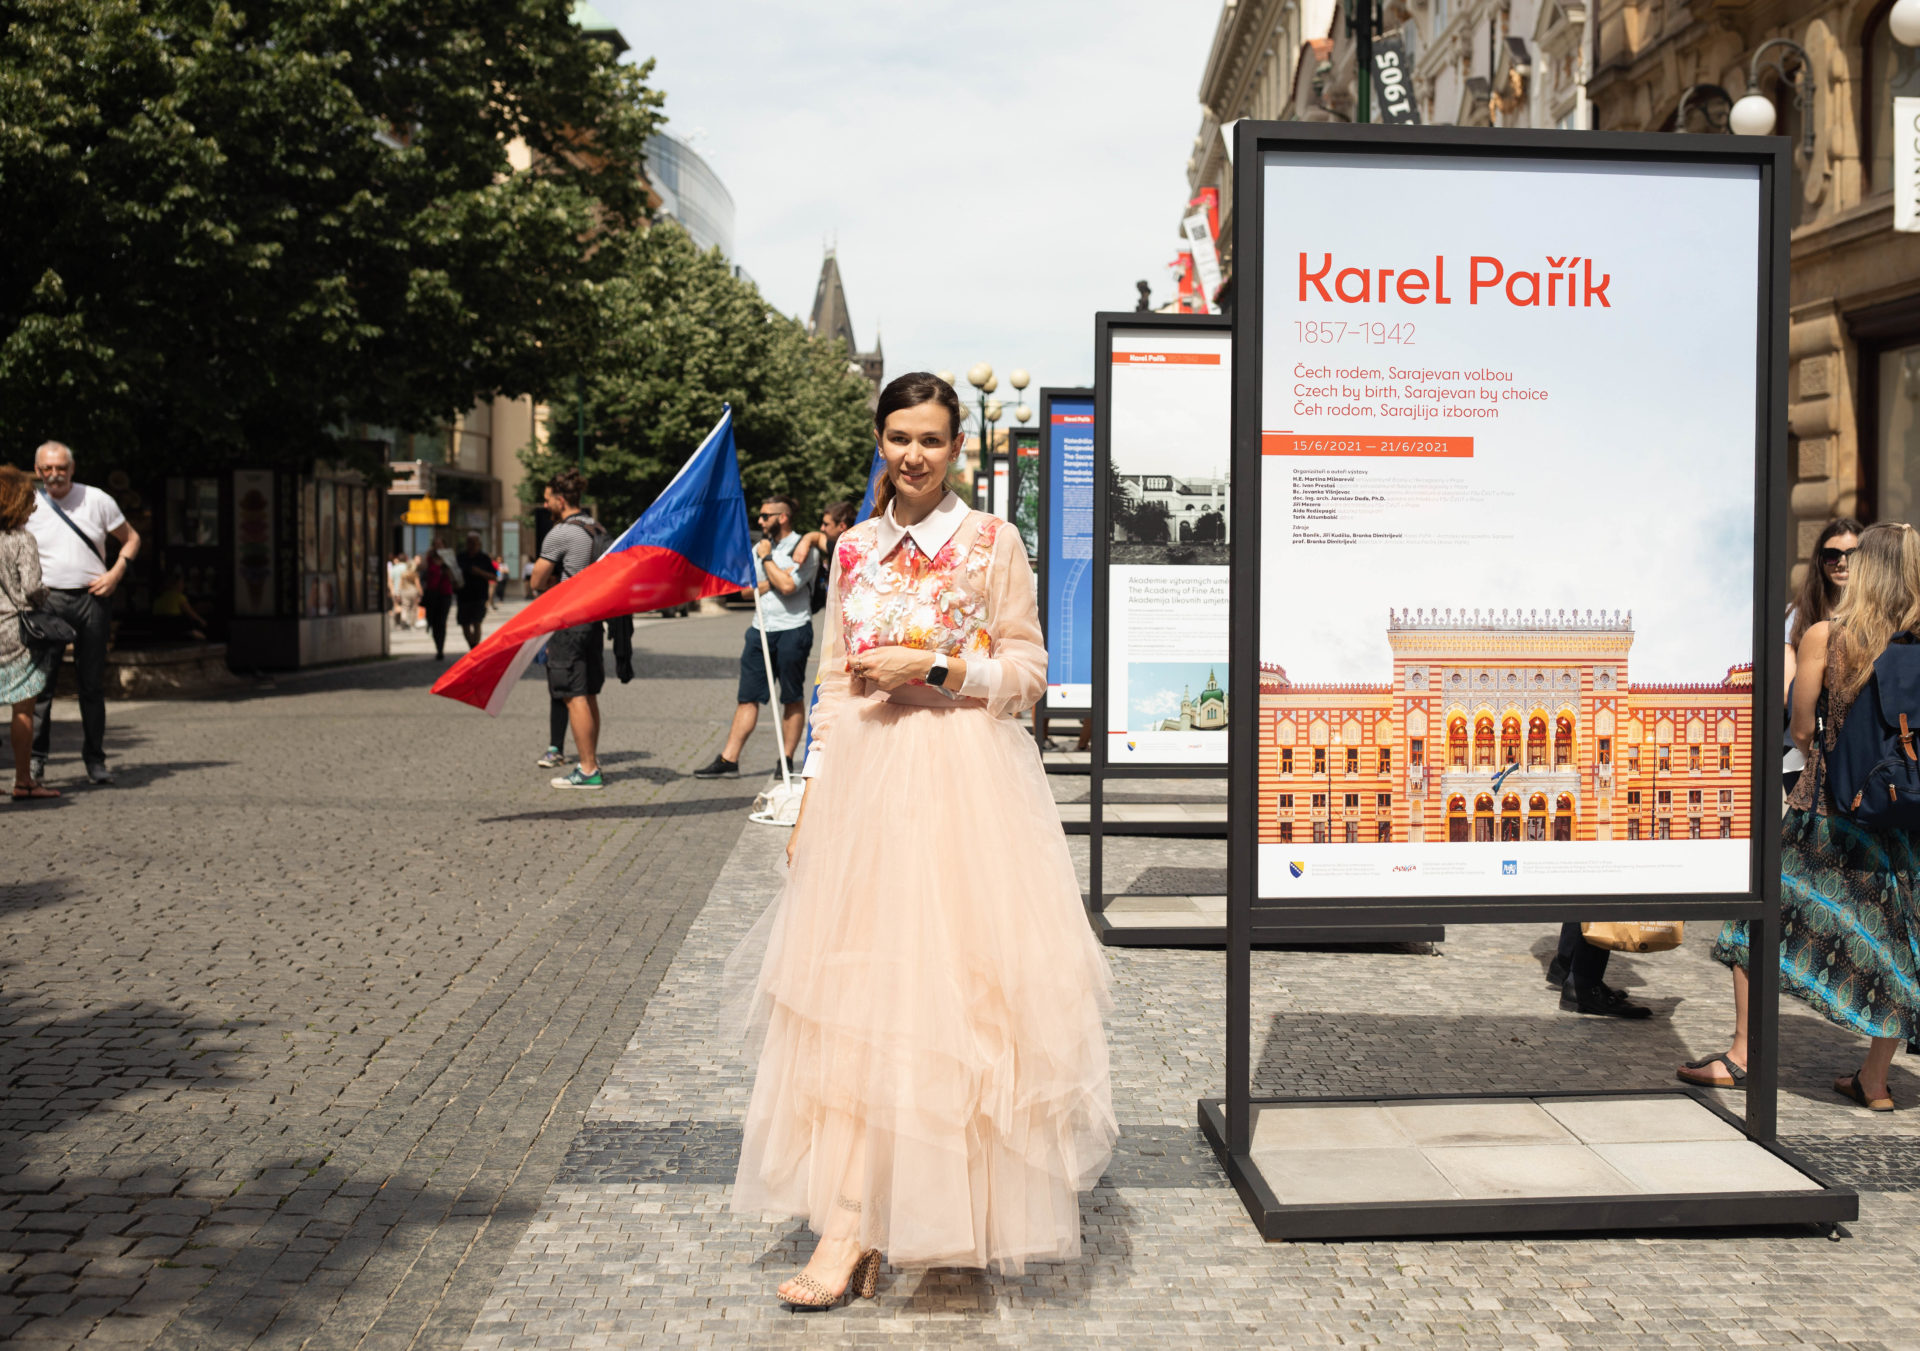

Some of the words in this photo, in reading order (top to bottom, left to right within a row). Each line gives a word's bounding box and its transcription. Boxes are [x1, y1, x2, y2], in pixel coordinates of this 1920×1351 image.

[1375, 50, 1411, 117] 1905
[1298, 251, 1452, 305] Karel
[1469, 255, 1612, 308] Pařík
[1293, 362, 1332, 379] Čech
[1335, 365, 1385, 381] rodem,
[1388, 366, 1460, 384] Sarajevan
[1463, 367, 1513, 382] volbou
[1293, 383, 1338, 399] Czech
[1342, 384, 1361, 402] by
[1364, 384, 1401, 401] birth,
[1404, 385, 1476, 403] Sarajevan
[1479, 386, 1498, 404] by
[1501, 386, 1549, 401] choice
[1293, 400, 1323, 416] Čeh
[1327, 402, 1377, 418] rodom,
[1380, 403, 1439, 421] Sarajlija
[1442, 404, 1499, 419] izborom
[1293, 440, 1361, 452] 15/6/2021
[1380, 441, 1448, 453] 21/6/2021
[1128, 586, 1143, 594] The
[1143, 586, 1181, 596] Academy
[1182, 586, 1190, 594] of
[1191, 586, 1208, 594] Fine
[1209, 587, 1225, 595] Arts
